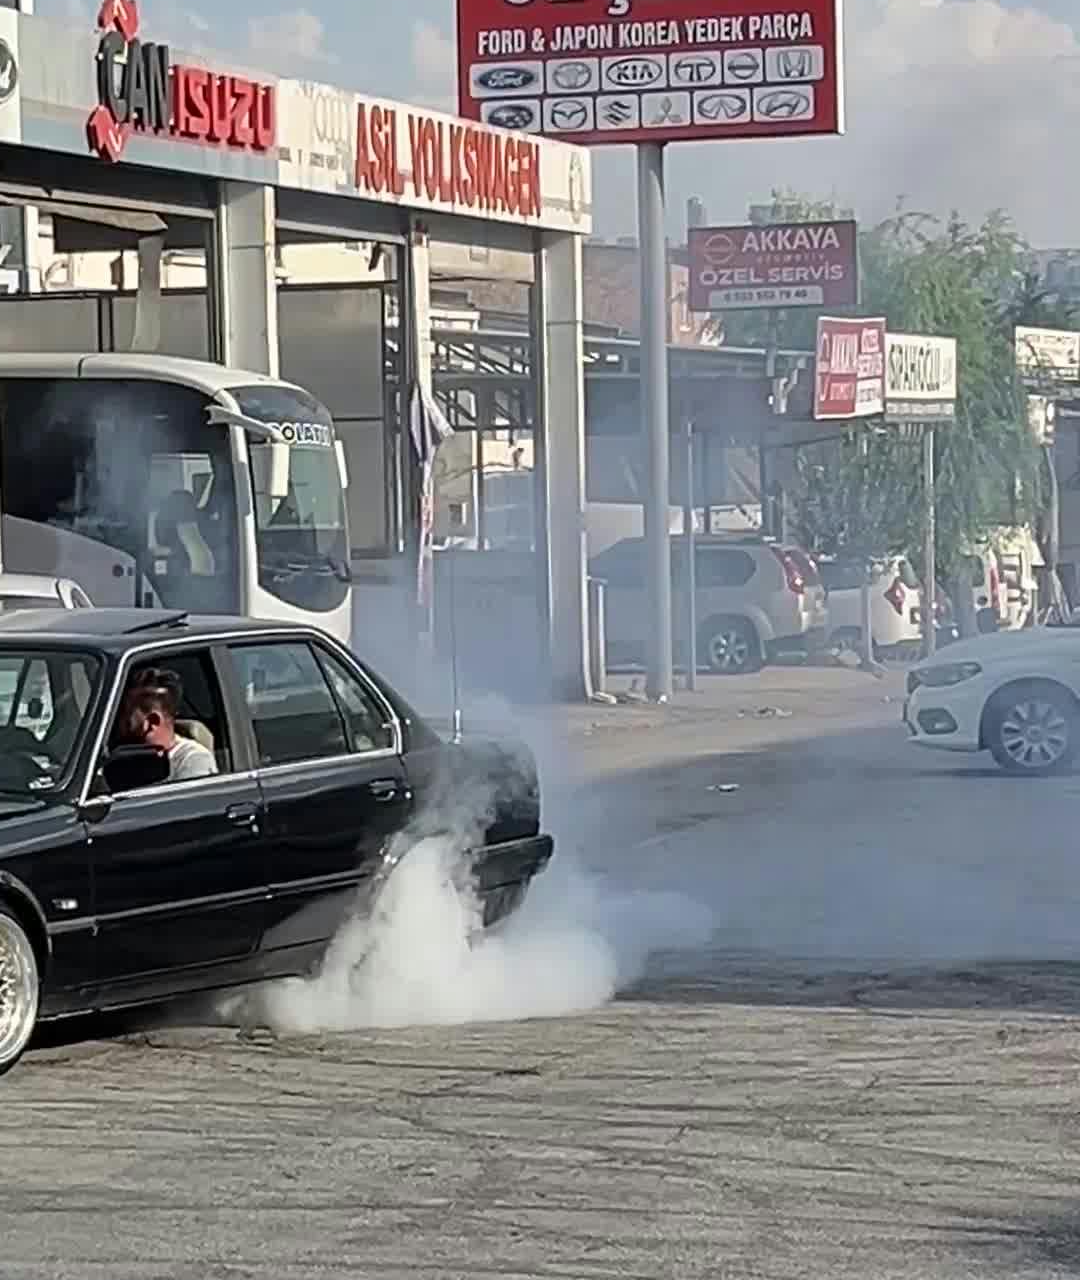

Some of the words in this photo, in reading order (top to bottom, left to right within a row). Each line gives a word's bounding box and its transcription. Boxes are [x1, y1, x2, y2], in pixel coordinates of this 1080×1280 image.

[477, 29, 526, 55] FORD
[531, 28, 546, 52] &
[550, 24, 613, 51] JAPON
[619, 20, 680, 47] KOREA
[684, 16, 744, 44] YEDEK
[748, 12, 813, 41] PARÇA
[616, 64, 654, 81] KIA
[170, 64, 275, 151] ISUZU
[407, 114, 542, 220] VOLKSWAGEN
[741, 227, 840, 252] AKKAYA
[699, 265, 765, 285] ÖZEL
[768, 262, 844, 283] SERVİS
